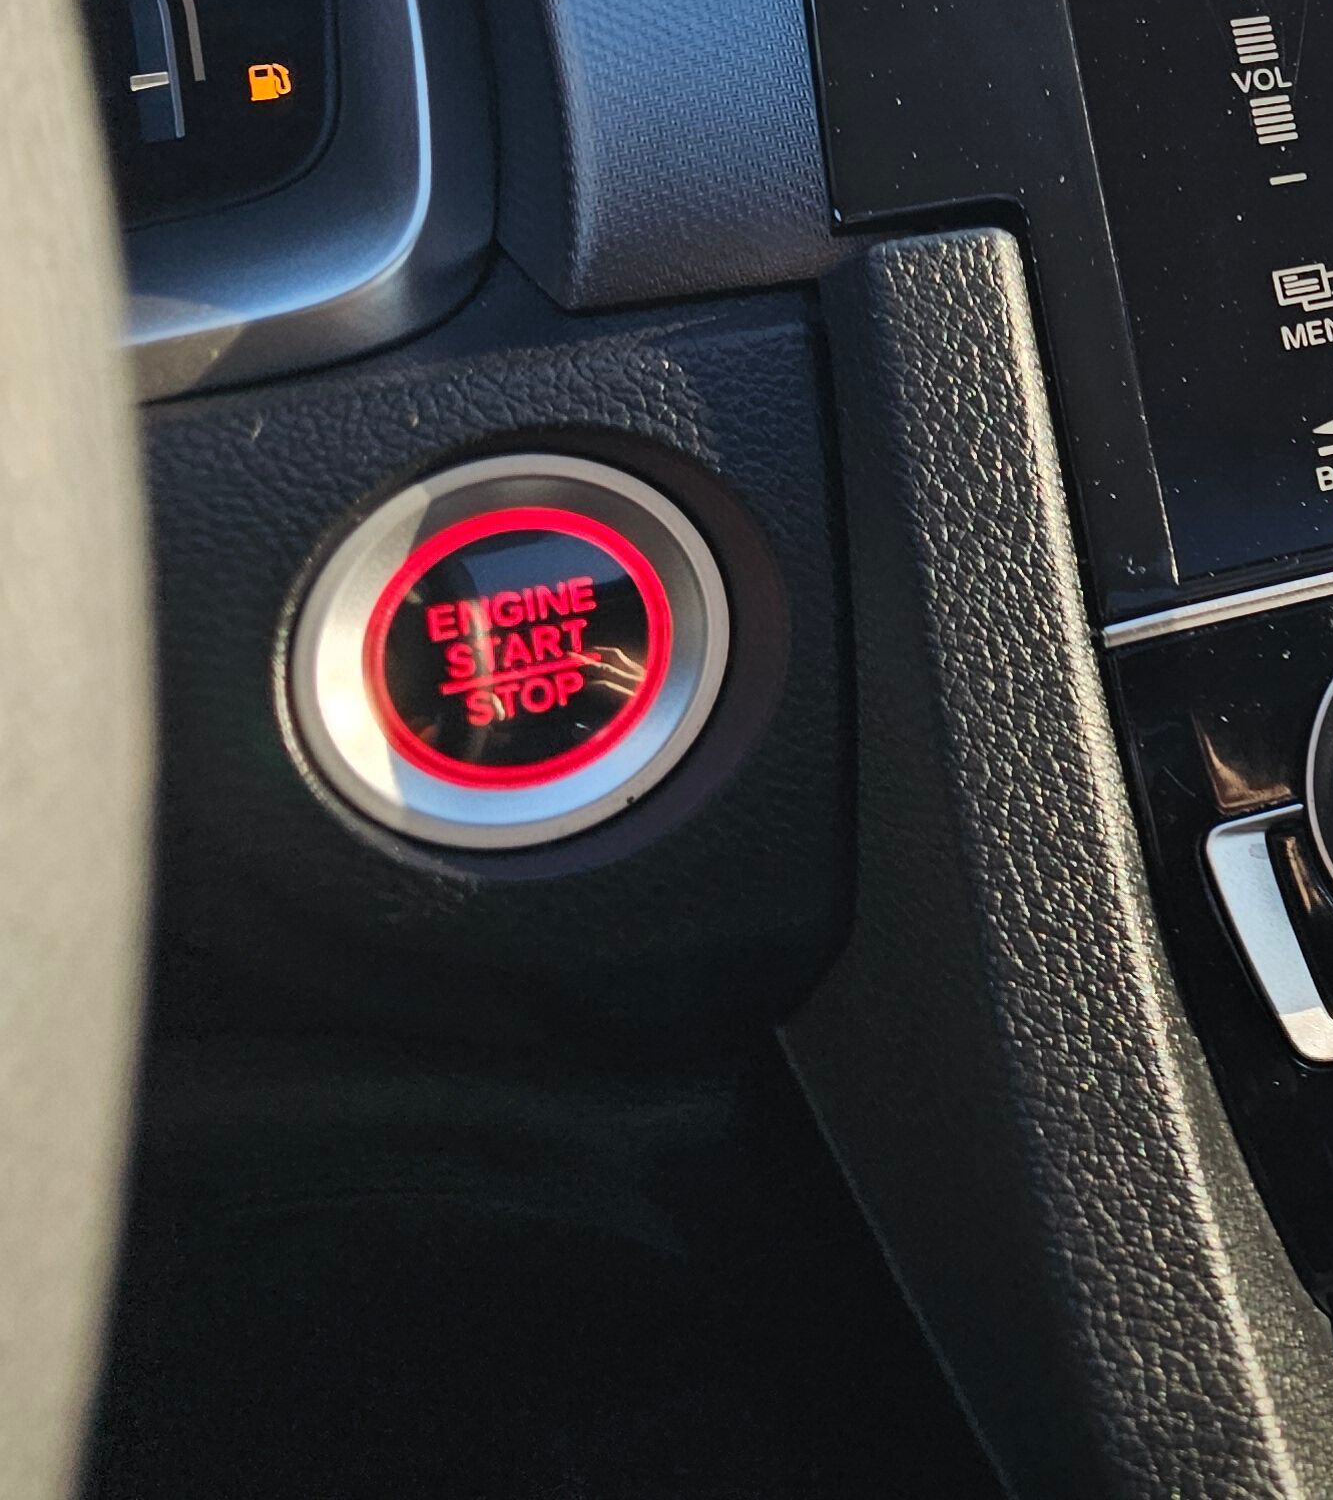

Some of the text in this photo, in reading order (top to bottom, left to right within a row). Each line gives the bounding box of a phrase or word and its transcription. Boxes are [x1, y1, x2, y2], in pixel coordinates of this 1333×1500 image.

[1230, 66, 1293, 94] VOL
[425, 576, 597, 644] ENGINE
[446, 619, 589, 680] START
[465, 668, 585, 728] STOP
